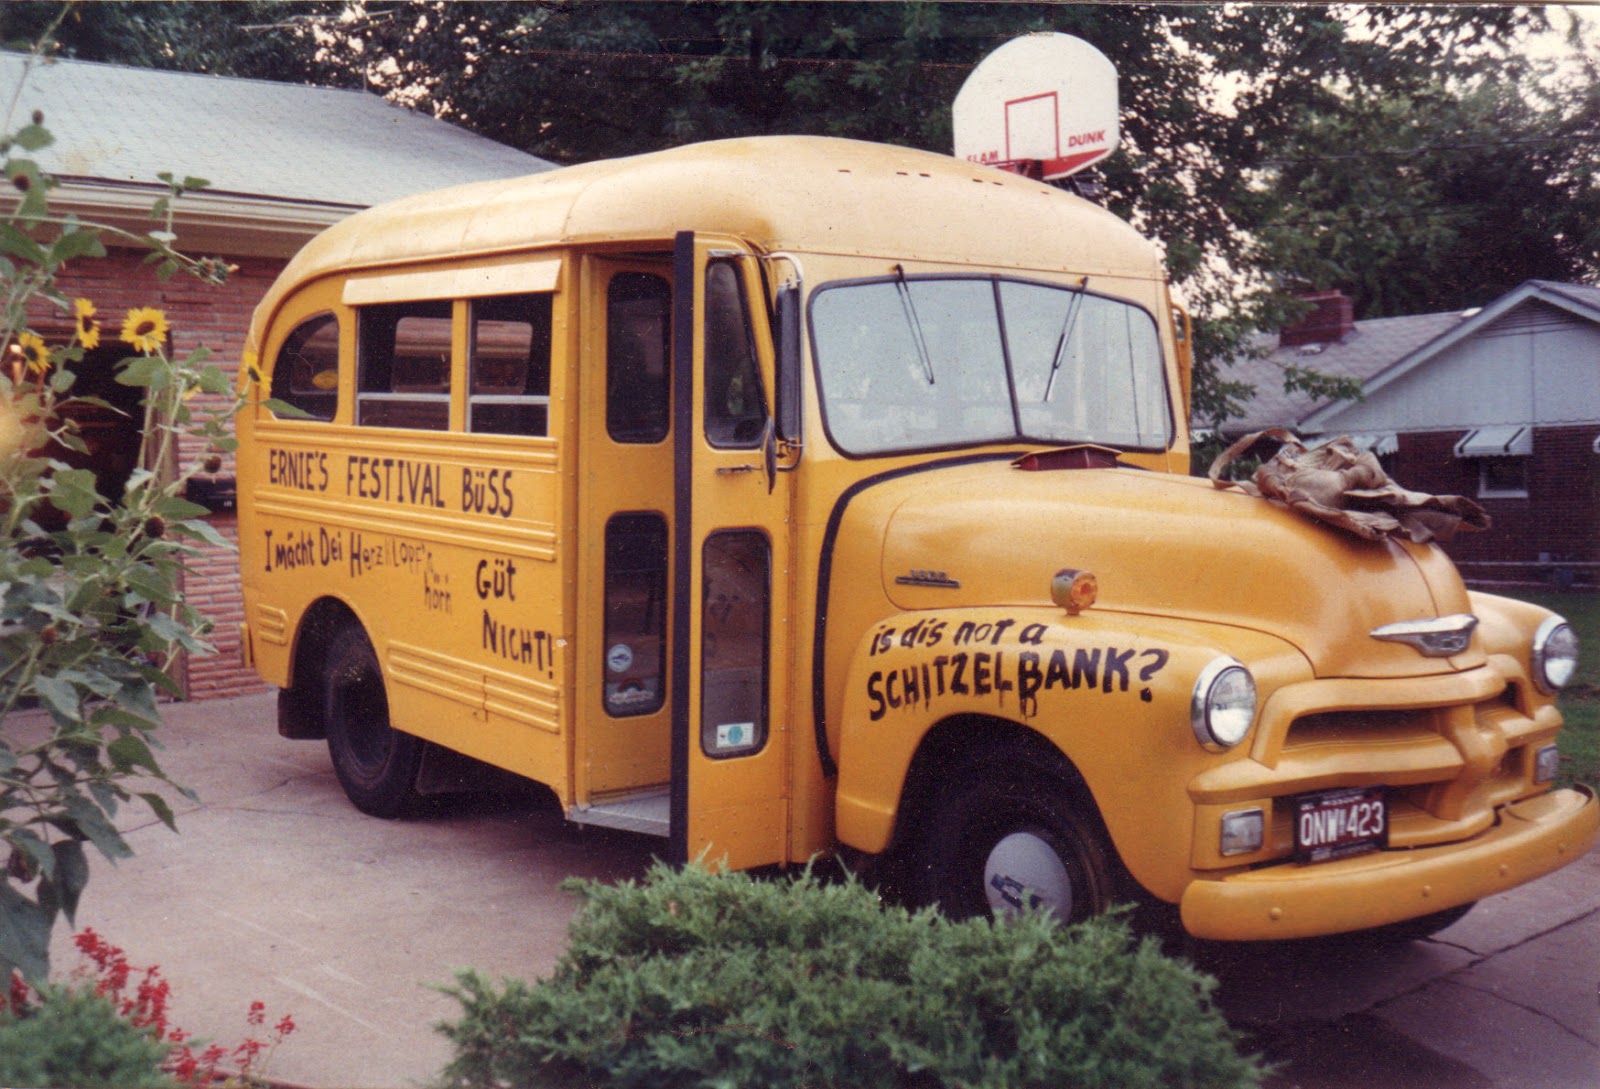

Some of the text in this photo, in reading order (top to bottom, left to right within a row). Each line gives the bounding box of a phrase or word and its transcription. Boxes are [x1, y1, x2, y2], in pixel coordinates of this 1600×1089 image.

[1068, 130, 1105, 147] DUNK
[269, 448, 329, 492] ERNIE'S
[346, 455, 446, 508] FESTIVAL
[264, 529, 273, 573] I
[869, 624, 896, 657] is
[900, 617, 950, 649] dis
[1018, 623, 1050, 646] a
[866, 647, 1170, 722] SCHITZELBANK?
